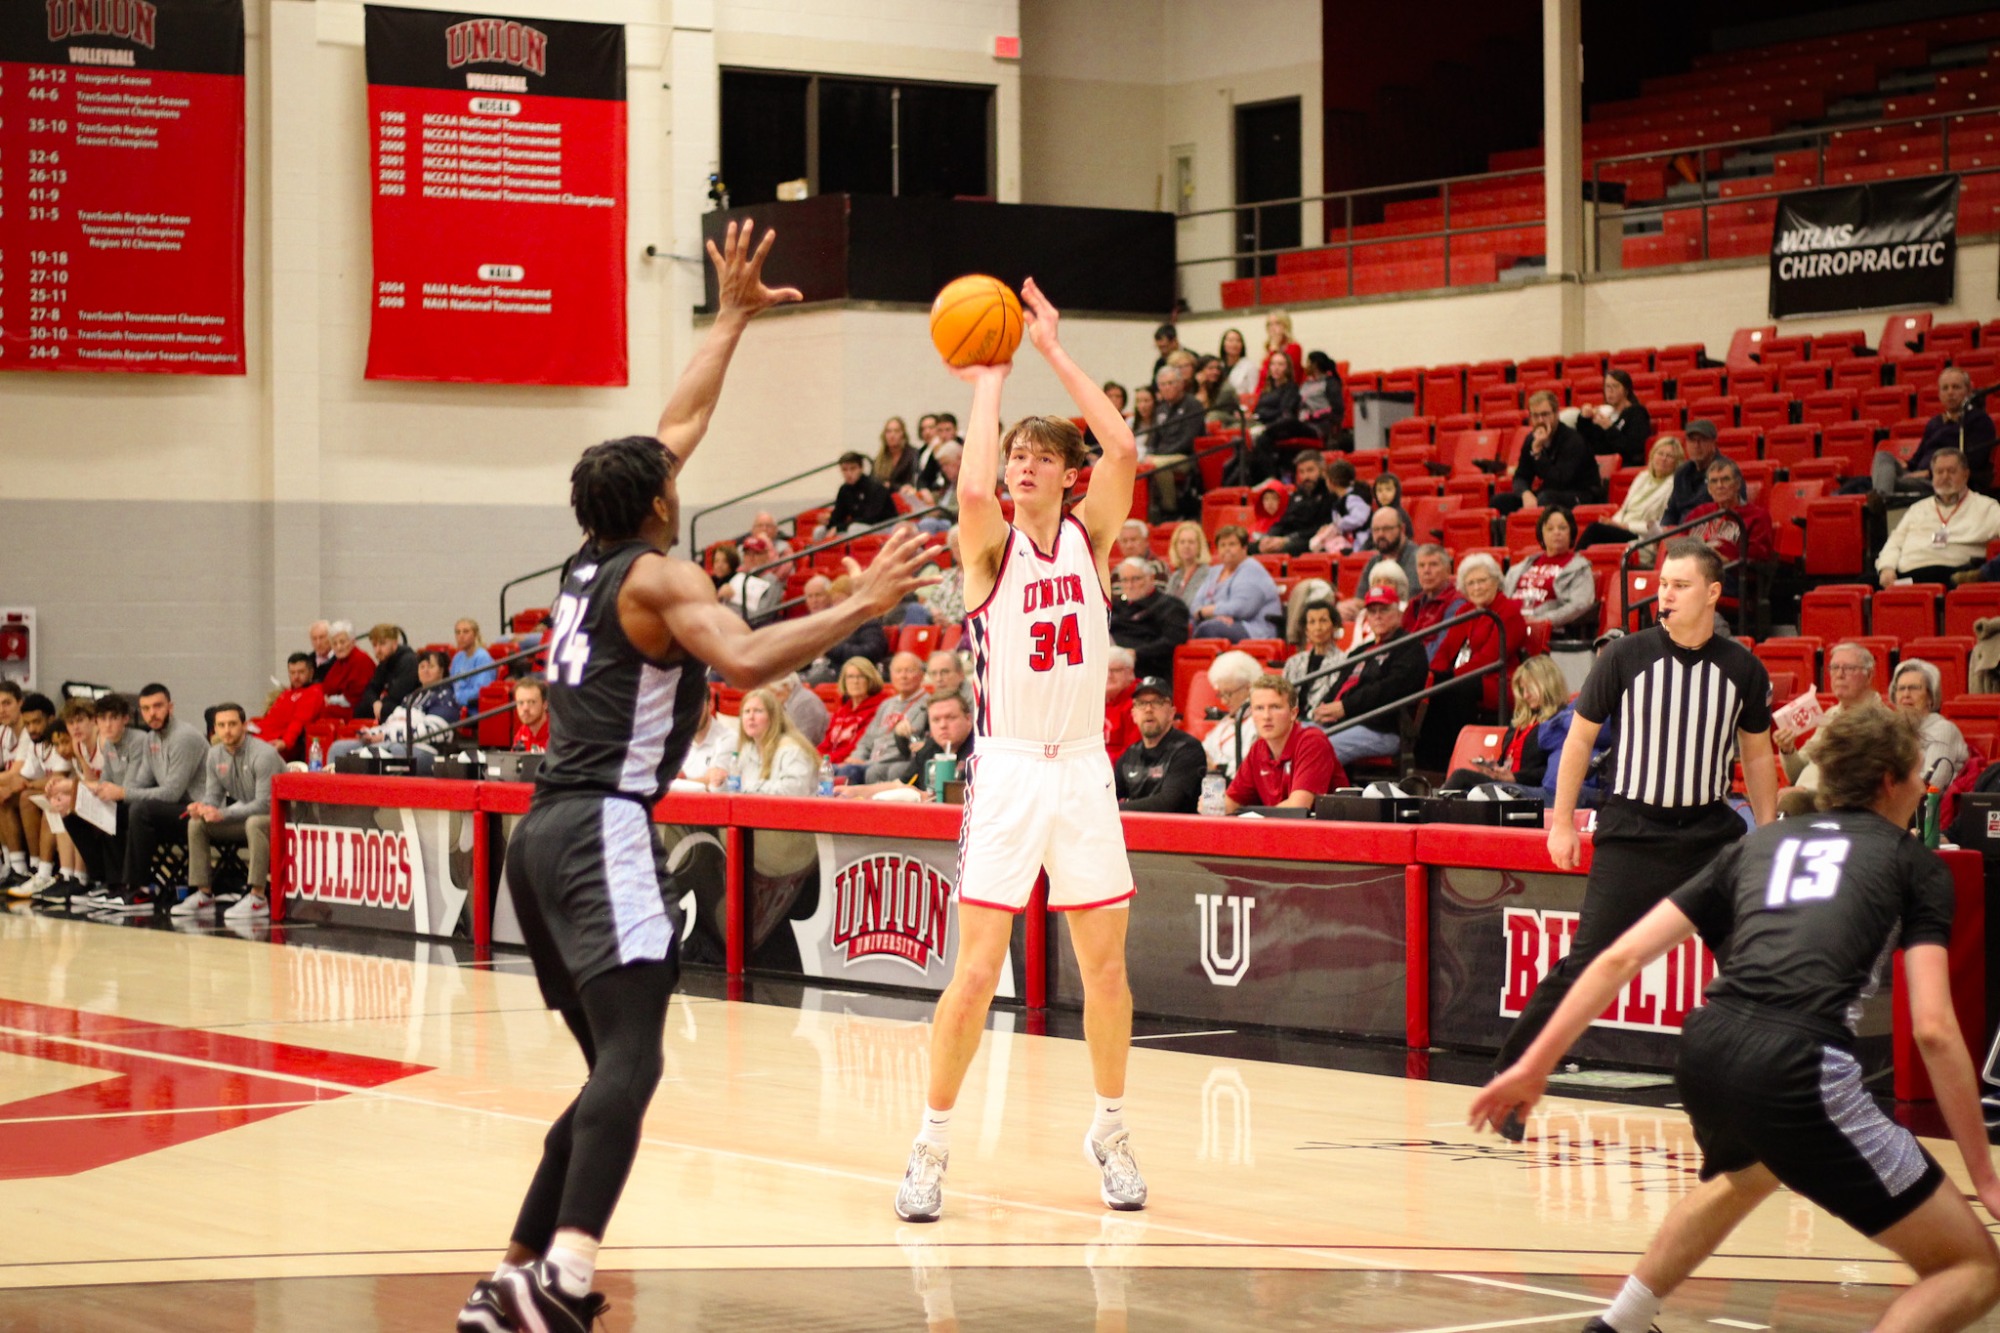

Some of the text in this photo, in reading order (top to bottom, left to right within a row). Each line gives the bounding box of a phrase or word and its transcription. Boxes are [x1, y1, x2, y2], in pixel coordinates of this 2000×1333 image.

[47, 0, 157, 49] UNION
[445, 18, 548, 77] UNION
[69, 47, 135, 67] VOLLEYBALL
[28, 68, 67, 83] 34-12
[119, 74, 152, 86] Season
[466, 73, 528, 93] VOLLEYBALL
[28, 86, 59, 102] 44-6
[123, 94, 157, 107] Regular
[158, 95, 190, 108] Season
[76, 103, 181, 119] Tournament Champions
[28, 118, 67, 133] 35-10
[423, 113, 562, 133] NCCAA National Tournament
[123, 125, 158, 138] Regular
[423, 127, 562, 147] NCCAA National Tournament
[76, 135, 159, 149] Season Champions
[28, 150, 60, 164] 32-6
[423, 142, 562, 161] NCCAA National Tournament
[423, 156, 562, 175] NCCAA National Tournament
[28, 168, 67, 183] 26-13
[423, 171, 562, 190] NCCAA National Tournament
[28, 187, 60, 202] 41-9
[423, 185, 616, 208] NCCAA National Tournament Champions
[29, 207, 60, 221] 31-5
[124, 212, 158, 224] Regular
[159, 213, 191, 225] Season
[81, 224, 186, 239] Tournament Champions
[1780, 223, 1854, 253] WILKS
[89, 237, 121, 250] Region
[132, 239, 182, 251] Champions
[30, 251, 68, 265] 19-18
[1778, 241, 1946, 281] CHIROPRACTIC
[29, 269, 69, 284] 27-10
[30, 288, 67, 302] 25-11
[423, 283, 552, 300] NAIA National Tournament
[423, 298, 552, 314] NAIA National Tournament
[30, 307, 61, 322] 27-8
[124, 311, 177, 323] Tournament
[178, 313, 226, 326] Champions
[29, 326, 68, 341] 30-10
[124, 330, 176, 343] Tournament
[29, 345, 60, 360] 24-9
[123, 350, 158, 362] Regular
[158, 350, 189, 362] Season
[190, 351, 239, 363] Champions
[1023, 573, 1085, 614] UNION
[546, 592, 591, 686] 24
[1029, 612, 1084, 672] 34
[285, 823, 415, 910] BULLDOGS
[1766, 838, 1853, 908] 13
[833, 853, 953, 965] UNION
[854, 932, 922, 960] UNIVERSITY
[1195, 893, 1255, 987] U
